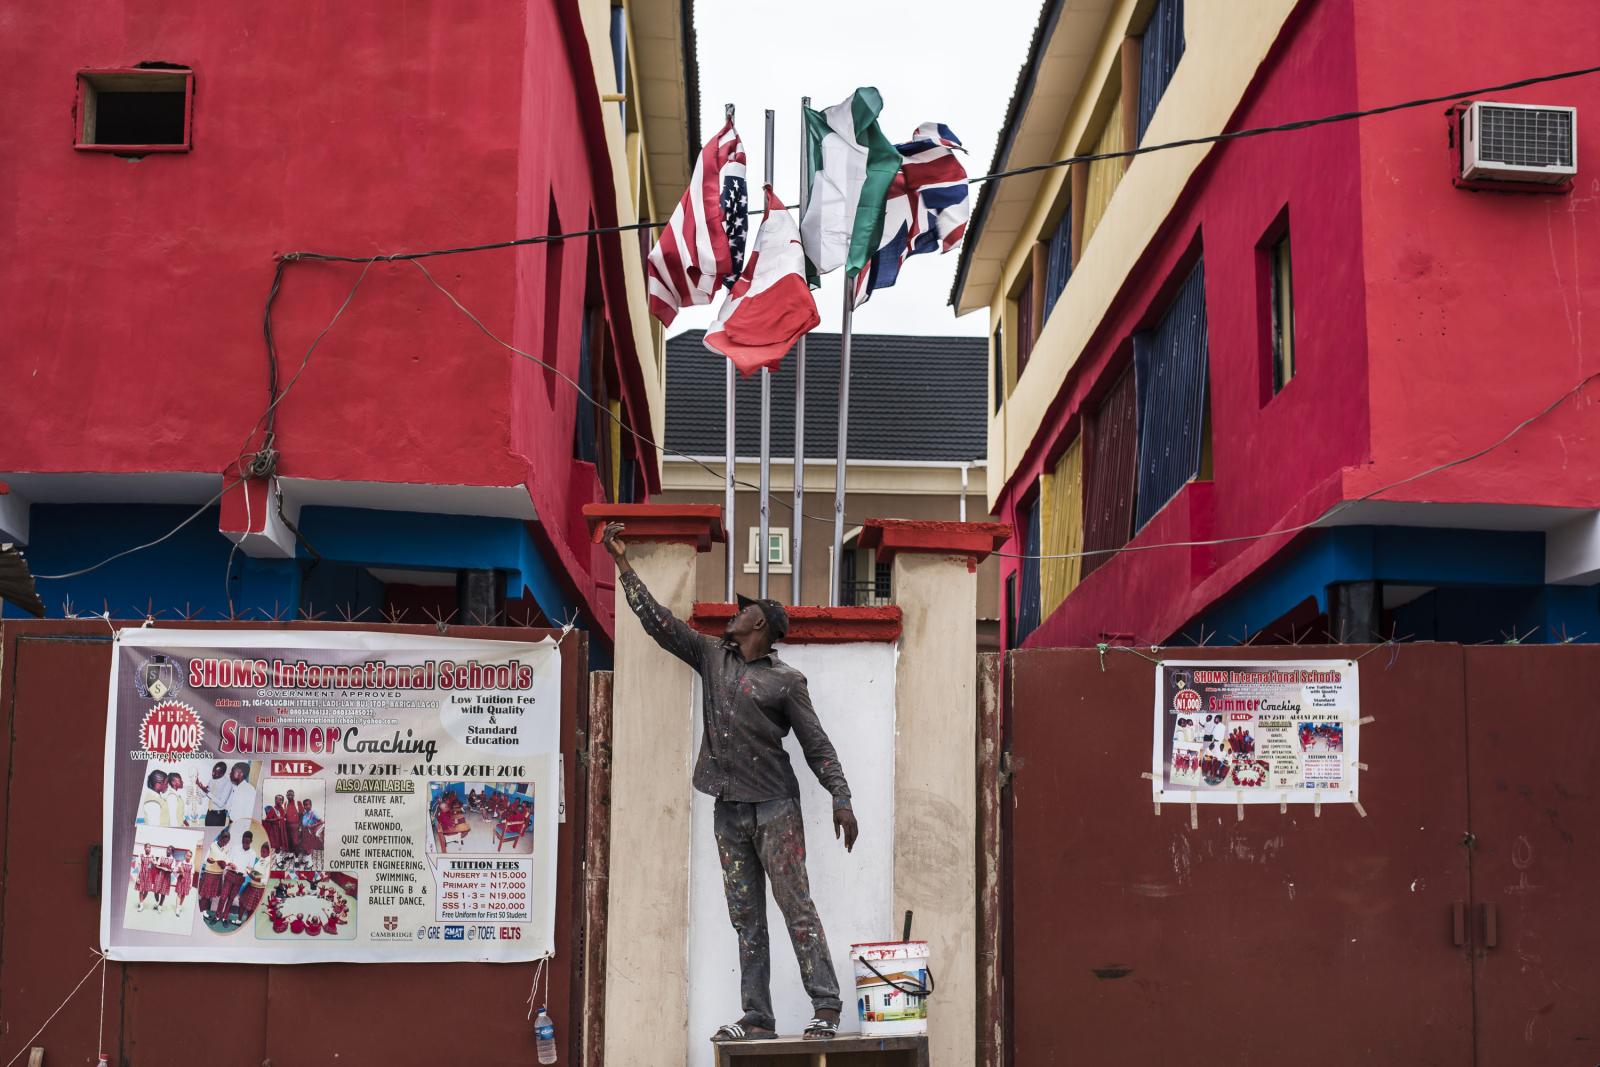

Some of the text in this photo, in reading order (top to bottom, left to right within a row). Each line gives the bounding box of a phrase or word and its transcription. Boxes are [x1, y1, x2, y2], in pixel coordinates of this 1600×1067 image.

[189, 658, 533, 690] SHOMS International Schools
[1194, 670, 1341, 684] SHOMS International Schools
[451, 695, 536, 704] Low Tuition Fee
[417, 701, 440, 709] LAGOS
[1210, 696, 1302, 714] Summer Coaching
[461, 706, 525, 716] with Quality
[158, 711, 190, 722] FEE:
[488, 716, 496, 724] &
[468, 726, 517, 734] Standard
[147, 724, 197, 752] N1,000
[219, 718, 438, 762] Summer Coaching
[465, 736, 520, 745] Education
[130, 751, 213, 760] With Free Notebooks
[274, 762, 313, 774] DATE:
[334, 763, 366, 776] JULY
[368, 764, 401, 776] 25TH
[410, 764, 460, 776] AUGUST
[462, 764, 495, 777] 26TH
[497, 765, 527, 777] 2016
[336, 779, 415, 792] ALSO AVAILABLE:
[353, 795, 406, 805] CREATIVE ART,
[364, 808, 394, 818] KARATE,
[354, 822, 403, 832] TAEKWONDO,
[342, 835, 414, 845] QUIZ COMPETITION,
[340, 848, 414, 858] GAME INTERACTION,
[330, 860, 426, 870] COMPUTER ENGINEERING,
[450, 860, 520, 870] TUITION FEES
[376, 873, 417, 883] SWIMMING,
[370, 886, 427, 894] SPELLING B &
[368, 896, 425, 906] BALLET DANCE,
[442, 902, 460, 910] SSS
[428, 926, 440, 939] GRE
[445, 927, 464, 938] GMAT
[478, 926, 496, 939] TOEFL
[500, 926, 521, 940] IELTS
